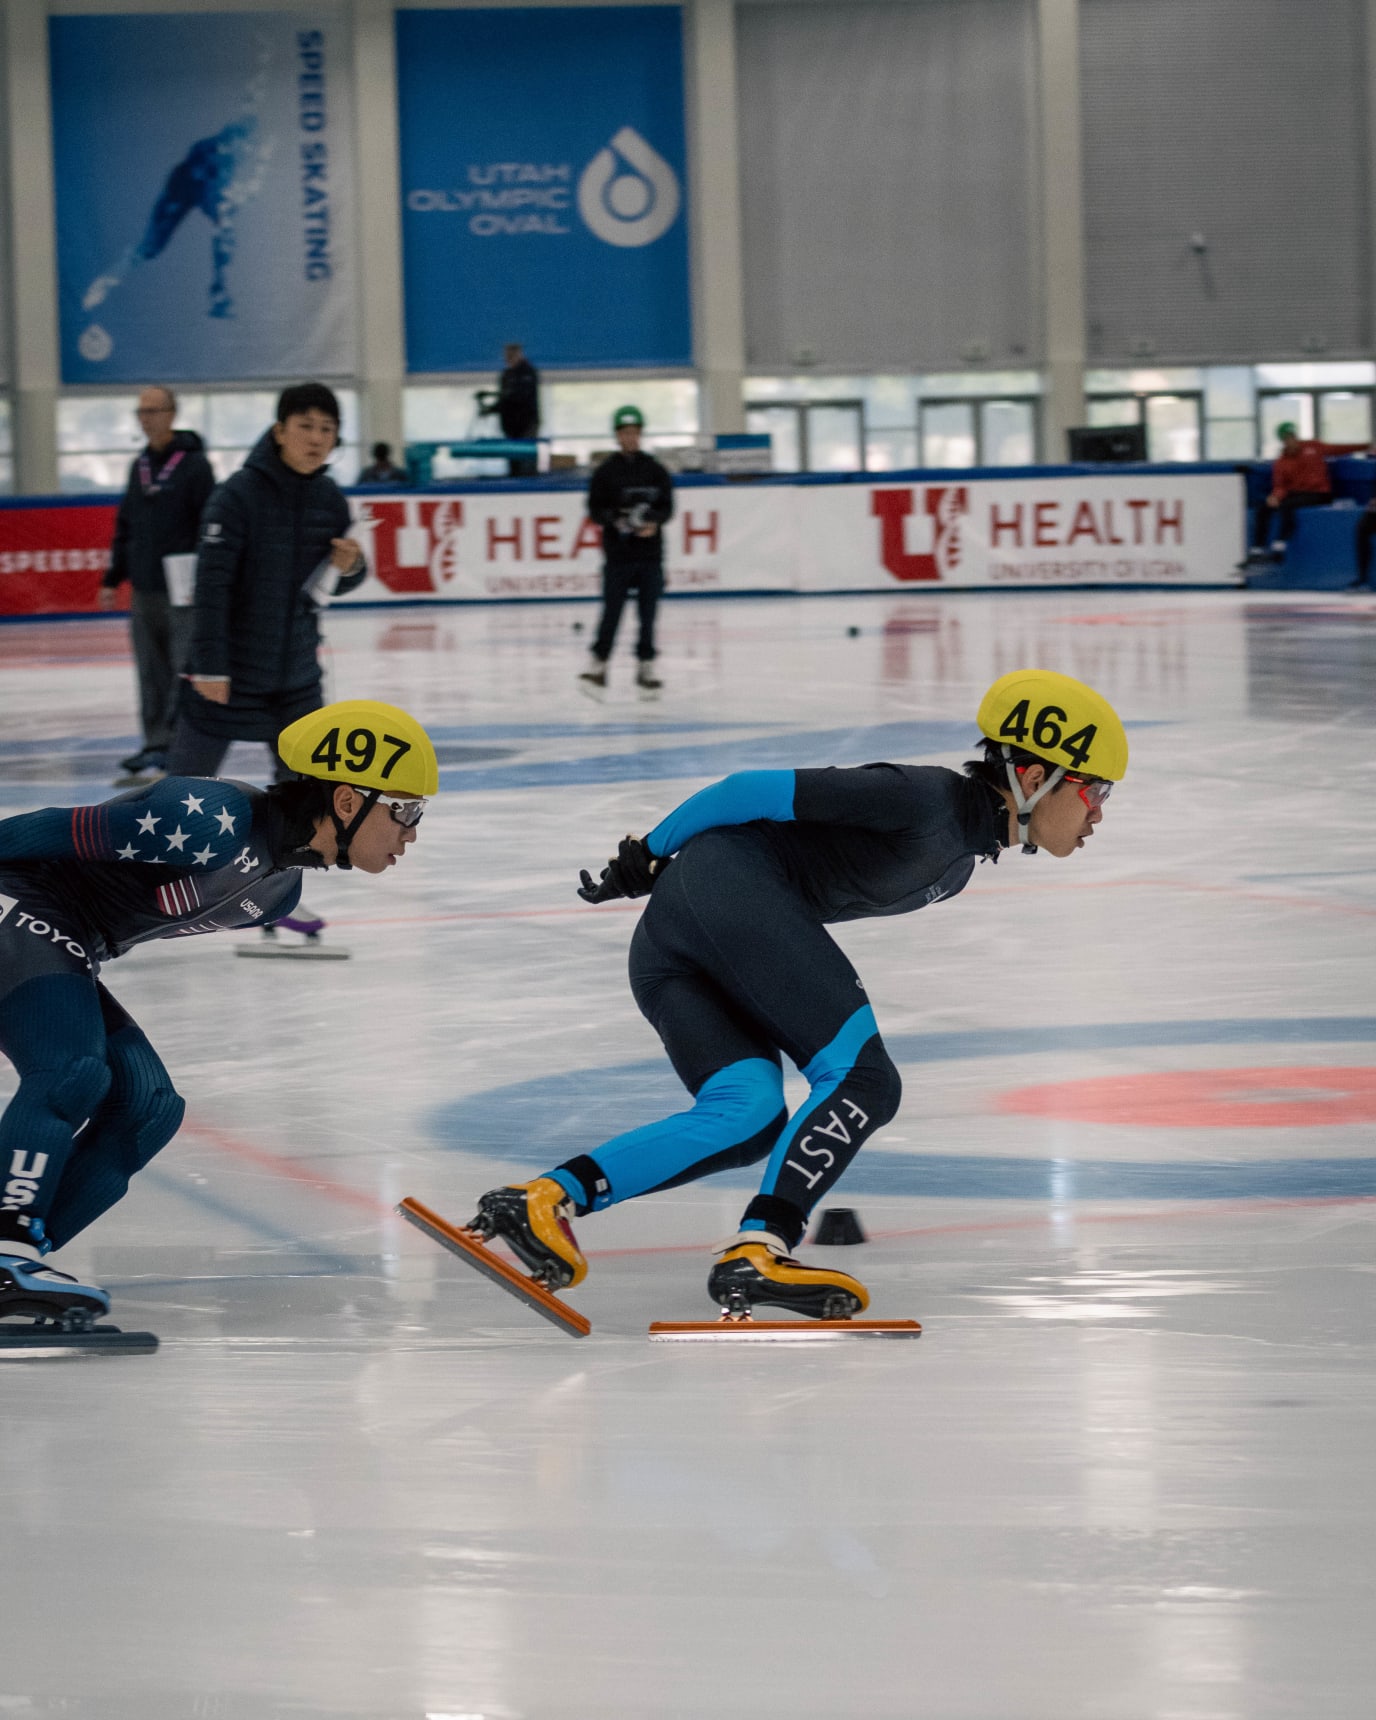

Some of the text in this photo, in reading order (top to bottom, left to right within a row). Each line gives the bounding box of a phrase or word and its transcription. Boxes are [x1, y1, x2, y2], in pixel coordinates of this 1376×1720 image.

[297, 29, 333, 281] SPEED SKATING
[467, 162, 571, 185] UTAH
[407, 187, 569, 211] OLYMPIC
[468, 213, 571, 236] OVAL
[485, 510, 719, 562] HEAH
[990, 500, 1184, 547] HEALTH
[311, 727, 412, 779] 497
[999, 699, 1098, 769] 464
[786, 1098, 869, 1190] FAST
